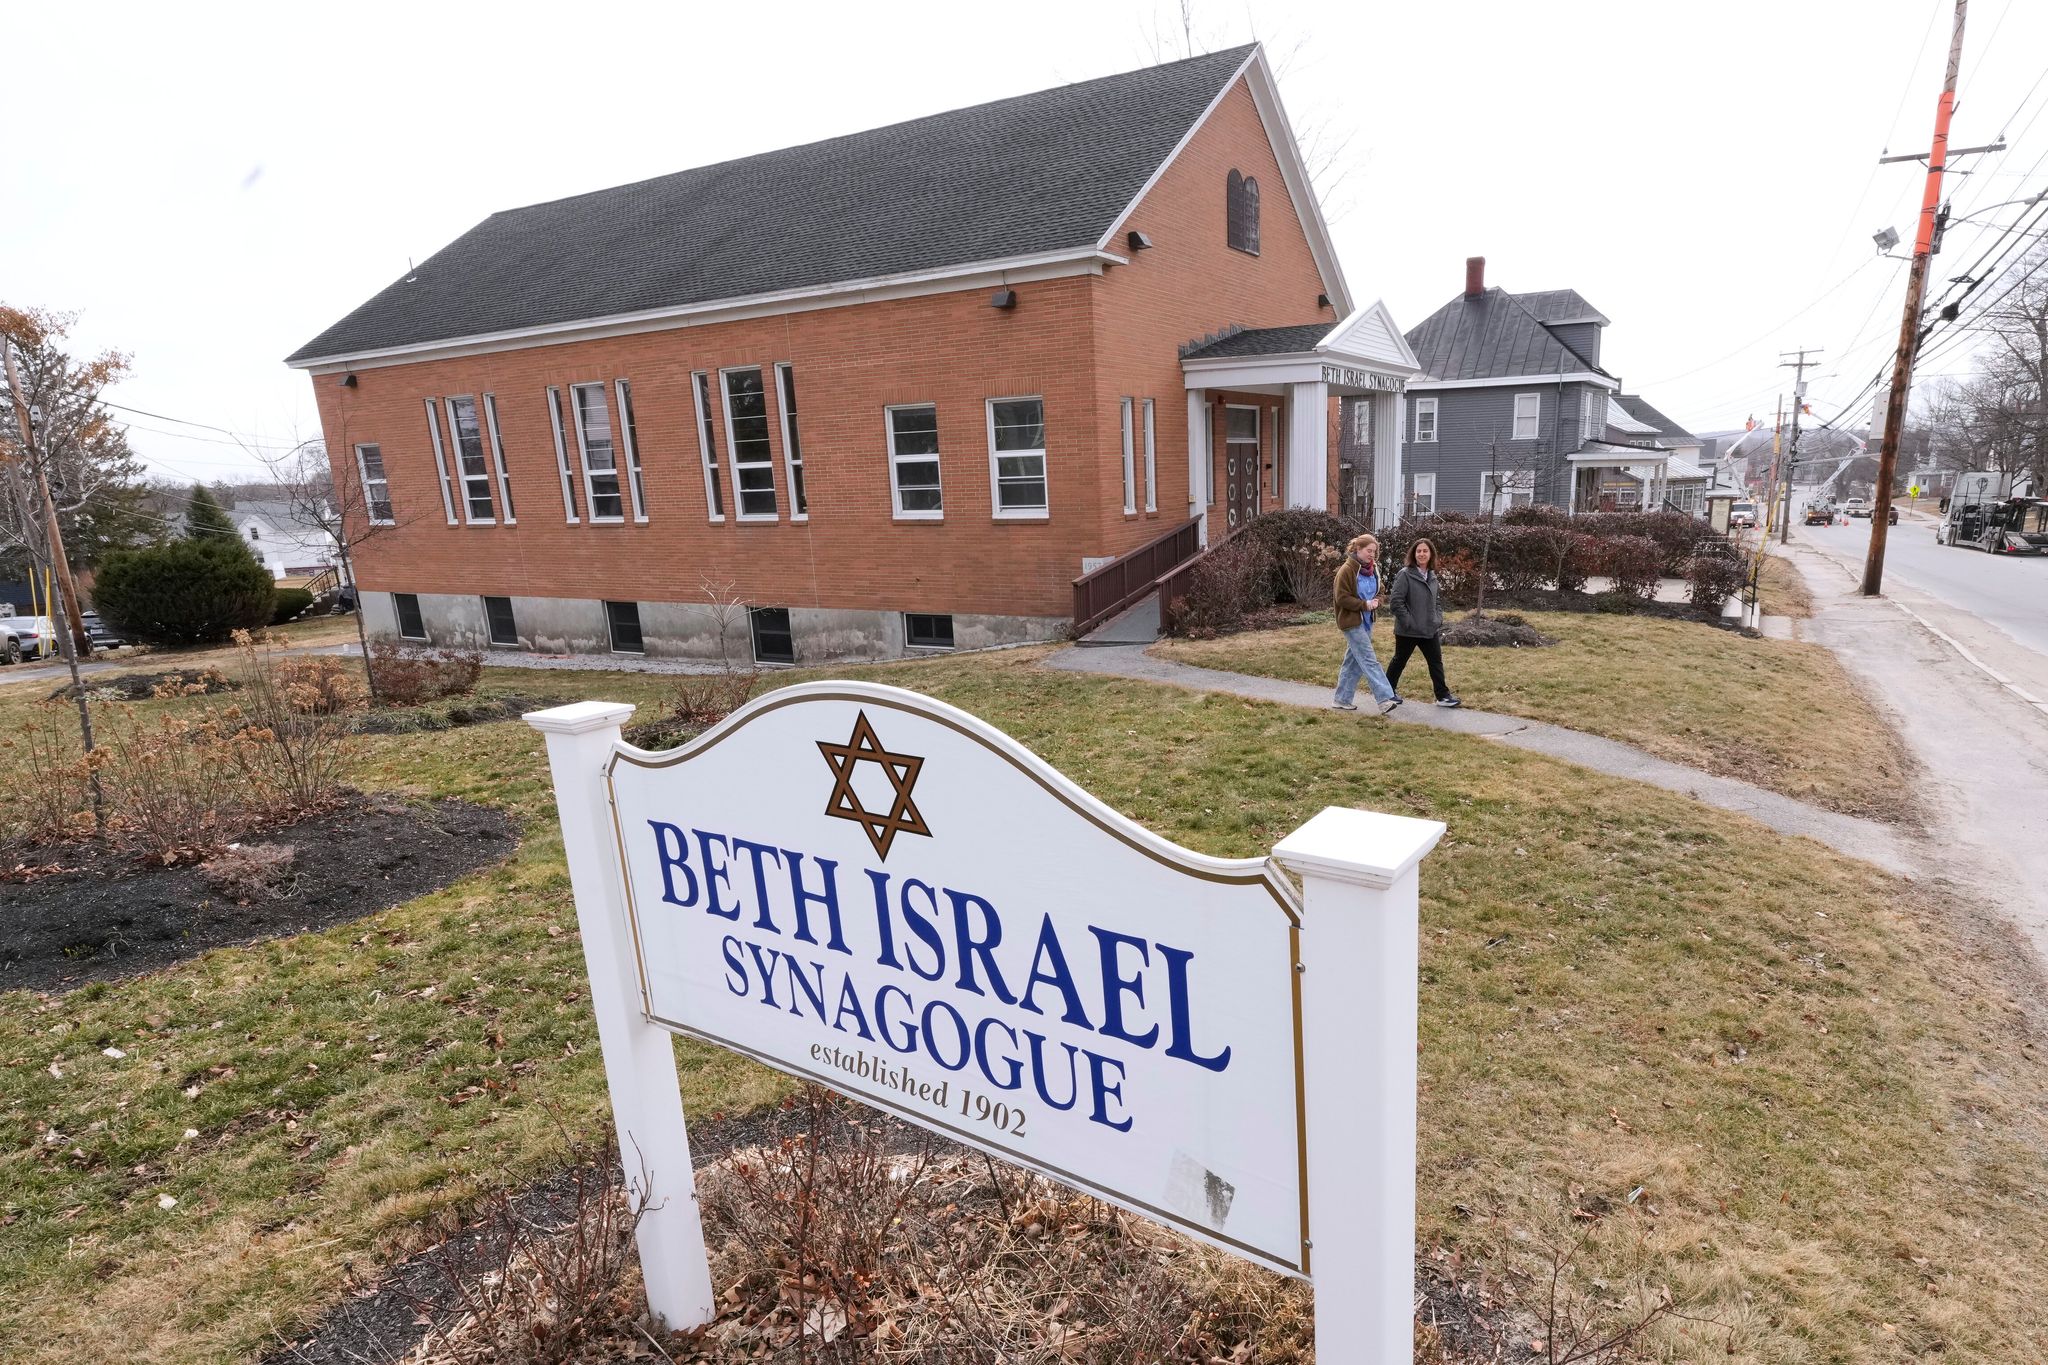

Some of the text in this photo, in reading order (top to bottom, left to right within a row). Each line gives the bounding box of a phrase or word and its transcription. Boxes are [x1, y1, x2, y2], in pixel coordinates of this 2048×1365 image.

[1321, 365, 1406, 394] BETH ISRAEL SYNAGOGUE
[648, 819, 1232, 1073] BETH ISRAEL
[722, 934, 1133, 1133] SYNAGOGUE
[810, 1040, 1027, 1139] established 1902
